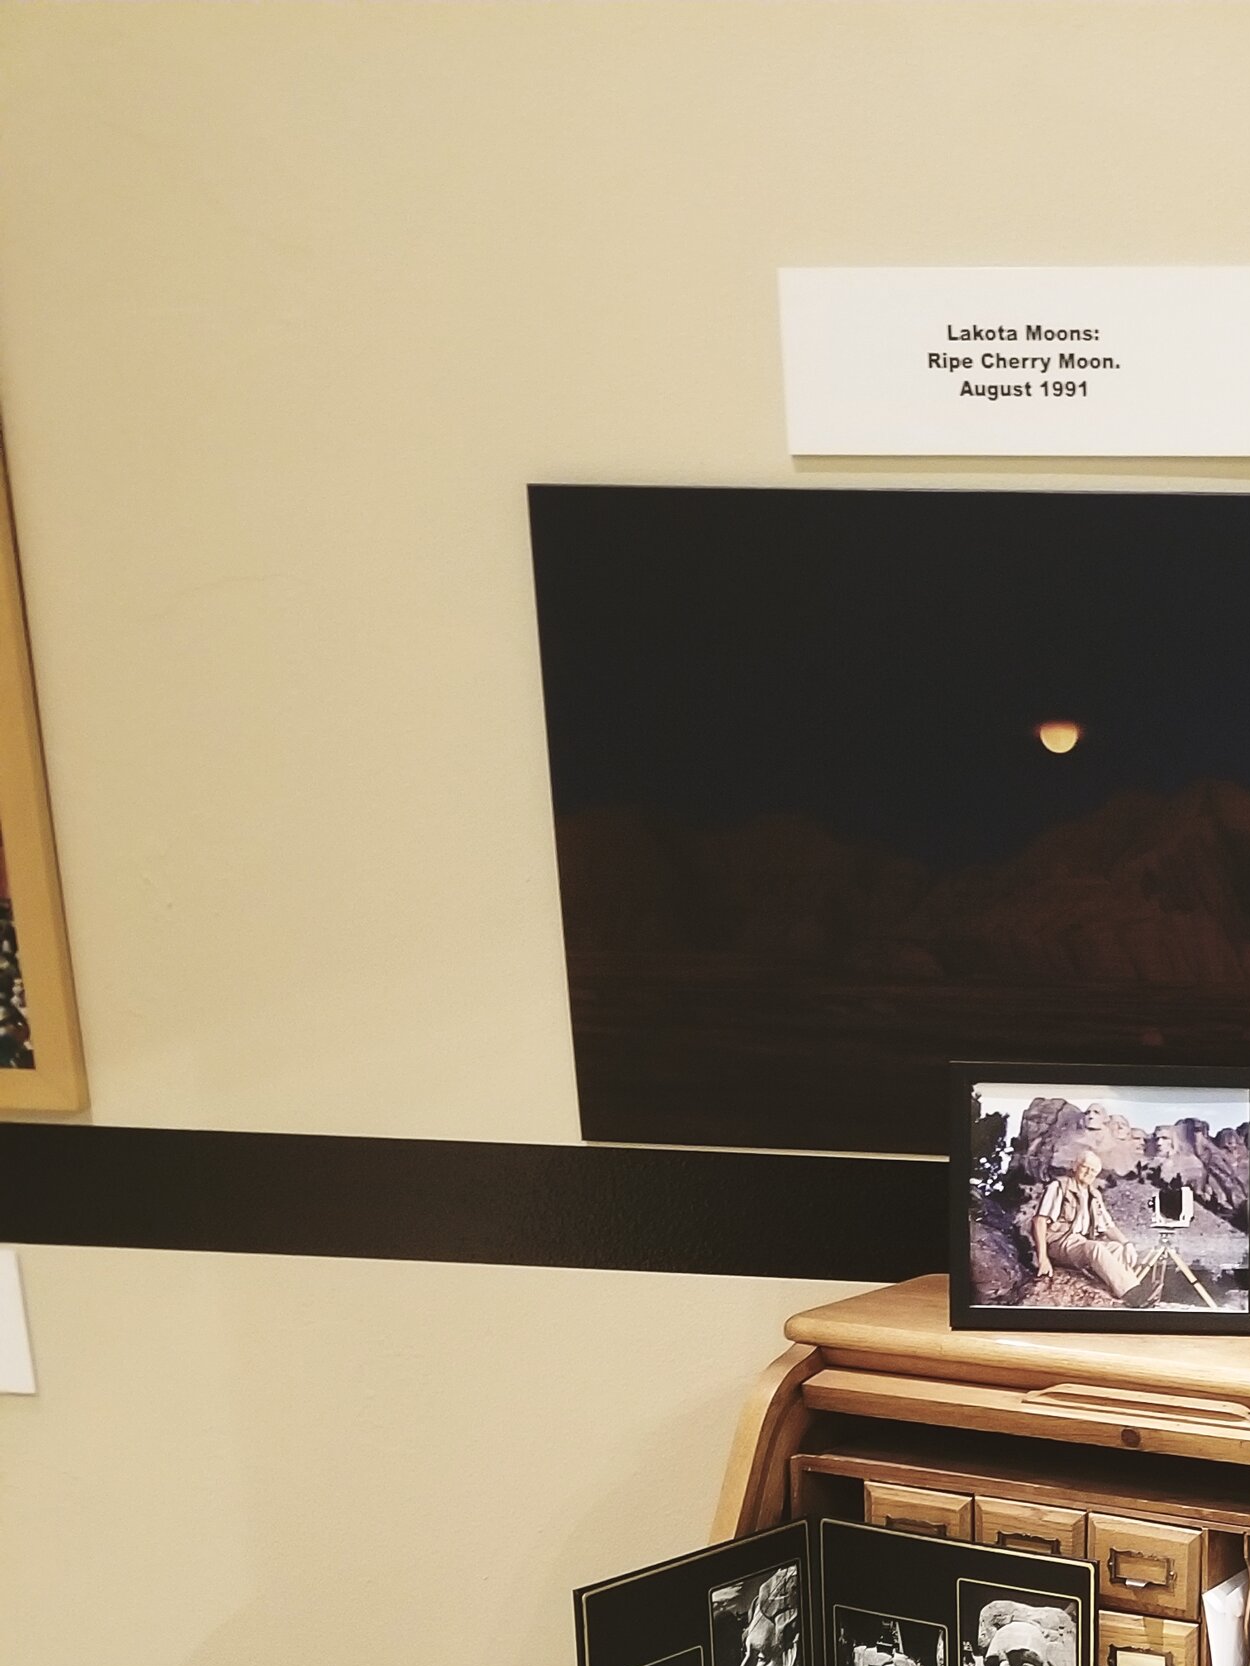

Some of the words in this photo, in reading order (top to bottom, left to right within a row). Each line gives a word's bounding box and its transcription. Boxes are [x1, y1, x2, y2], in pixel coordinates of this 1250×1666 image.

[947, 324, 1018, 342] Lakota
[1026, 324, 1099, 342] Moons:
[928, 352, 973, 372] Ripe
[981, 352, 1051, 374] Cherry
[1059, 352, 1120, 370] Moon.
[959, 380, 1032, 401] August
[1040, 380, 1087, 398] 1991
